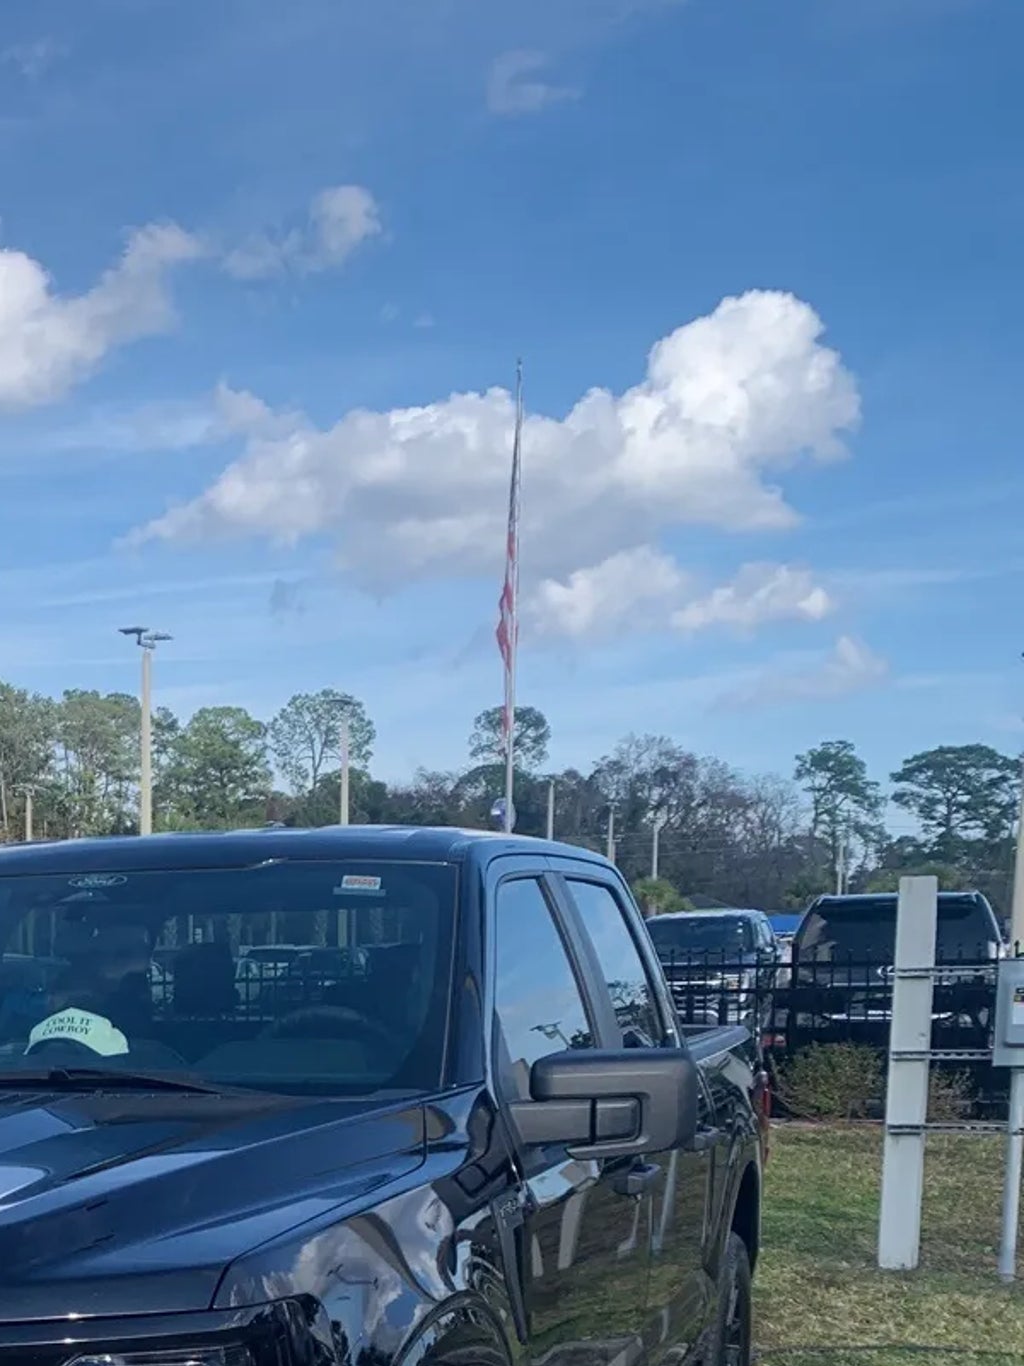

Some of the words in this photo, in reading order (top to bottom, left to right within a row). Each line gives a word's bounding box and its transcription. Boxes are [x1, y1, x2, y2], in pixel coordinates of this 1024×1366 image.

[46, 1016, 74, 1027] COOL
[79, 1017, 92, 1026] IT
[42, 1025, 92, 1036] COWBOY
